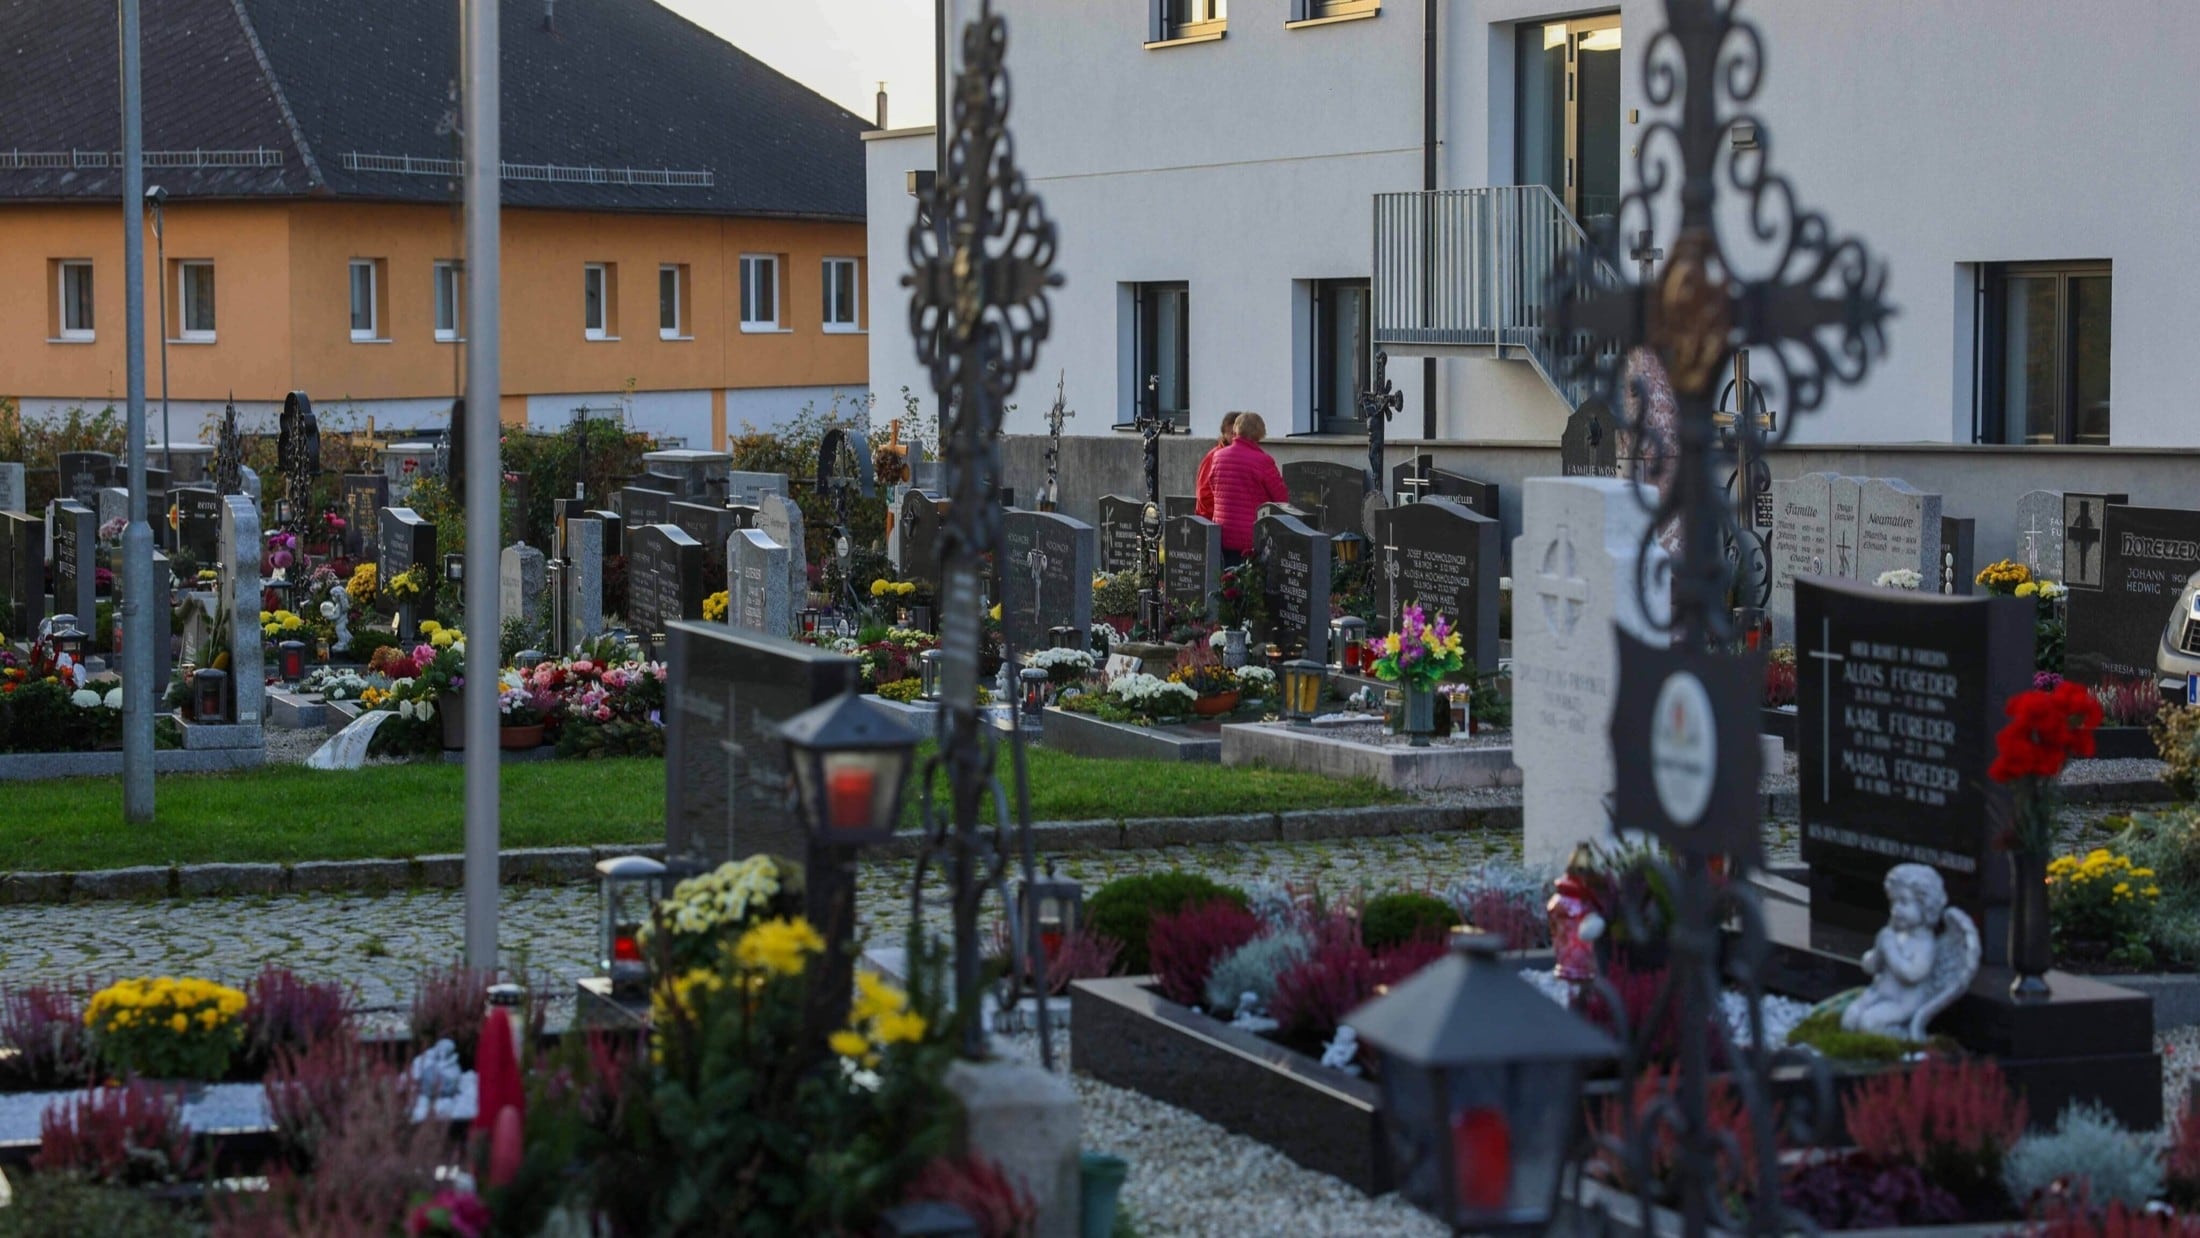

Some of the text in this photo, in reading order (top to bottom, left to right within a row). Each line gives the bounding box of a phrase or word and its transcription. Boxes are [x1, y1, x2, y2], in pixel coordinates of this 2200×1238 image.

[1567, 464, 1595, 476] FAMILIE
[1785, 502, 1818, 518] Familie
[1406, 548, 1467, 566] JOSEF HOCHHOLDINGER
[1425, 572, 1470, 587] HOCHHOLDINGER
[2127, 567, 2166, 581] JOHANN
[2126, 581, 2161, 595] HEDWIG
[1843, 661, 1885, 688] ALOIS
[2102, 661, 2135, 674] THERESIA
[1845, 706, 1882, 732] KARL
[1842, 749, 1888, 778] MARIA
